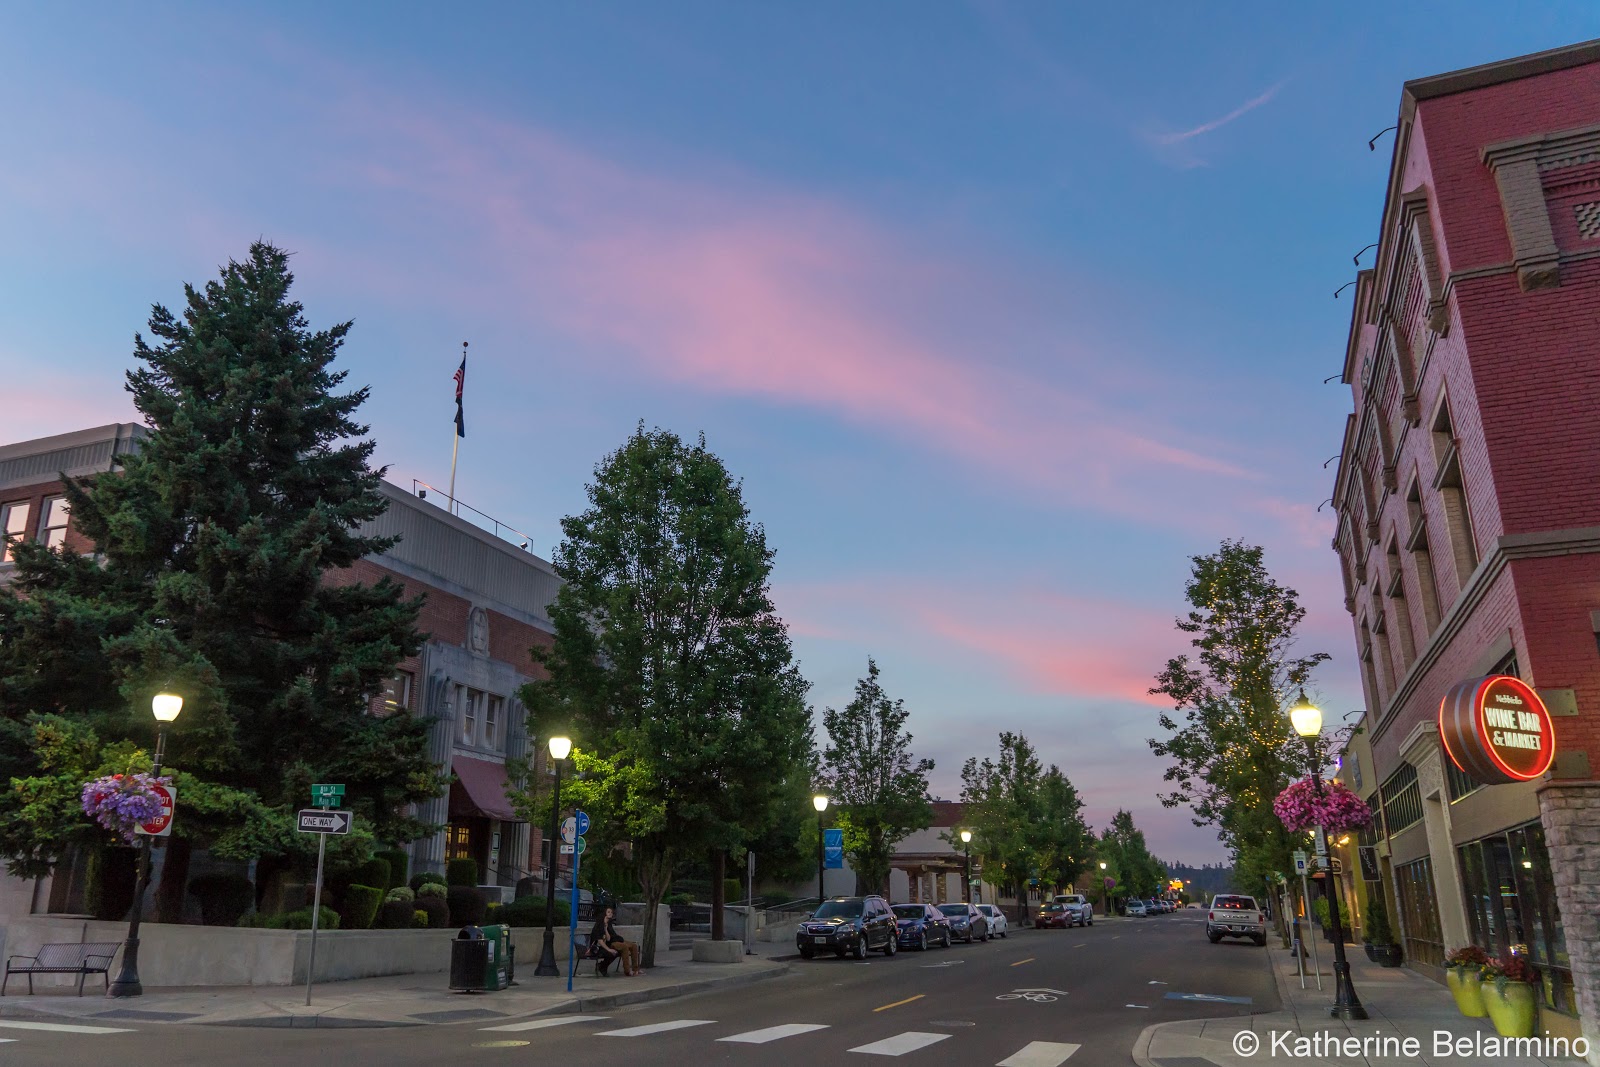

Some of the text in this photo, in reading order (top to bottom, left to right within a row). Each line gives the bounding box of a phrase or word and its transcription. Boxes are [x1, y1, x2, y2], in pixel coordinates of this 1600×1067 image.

[1485, 707, 1542, 733] WINE BAR
[318, 797, 329, 805] Main
[303, 817, 334, 826] ONE WAY
